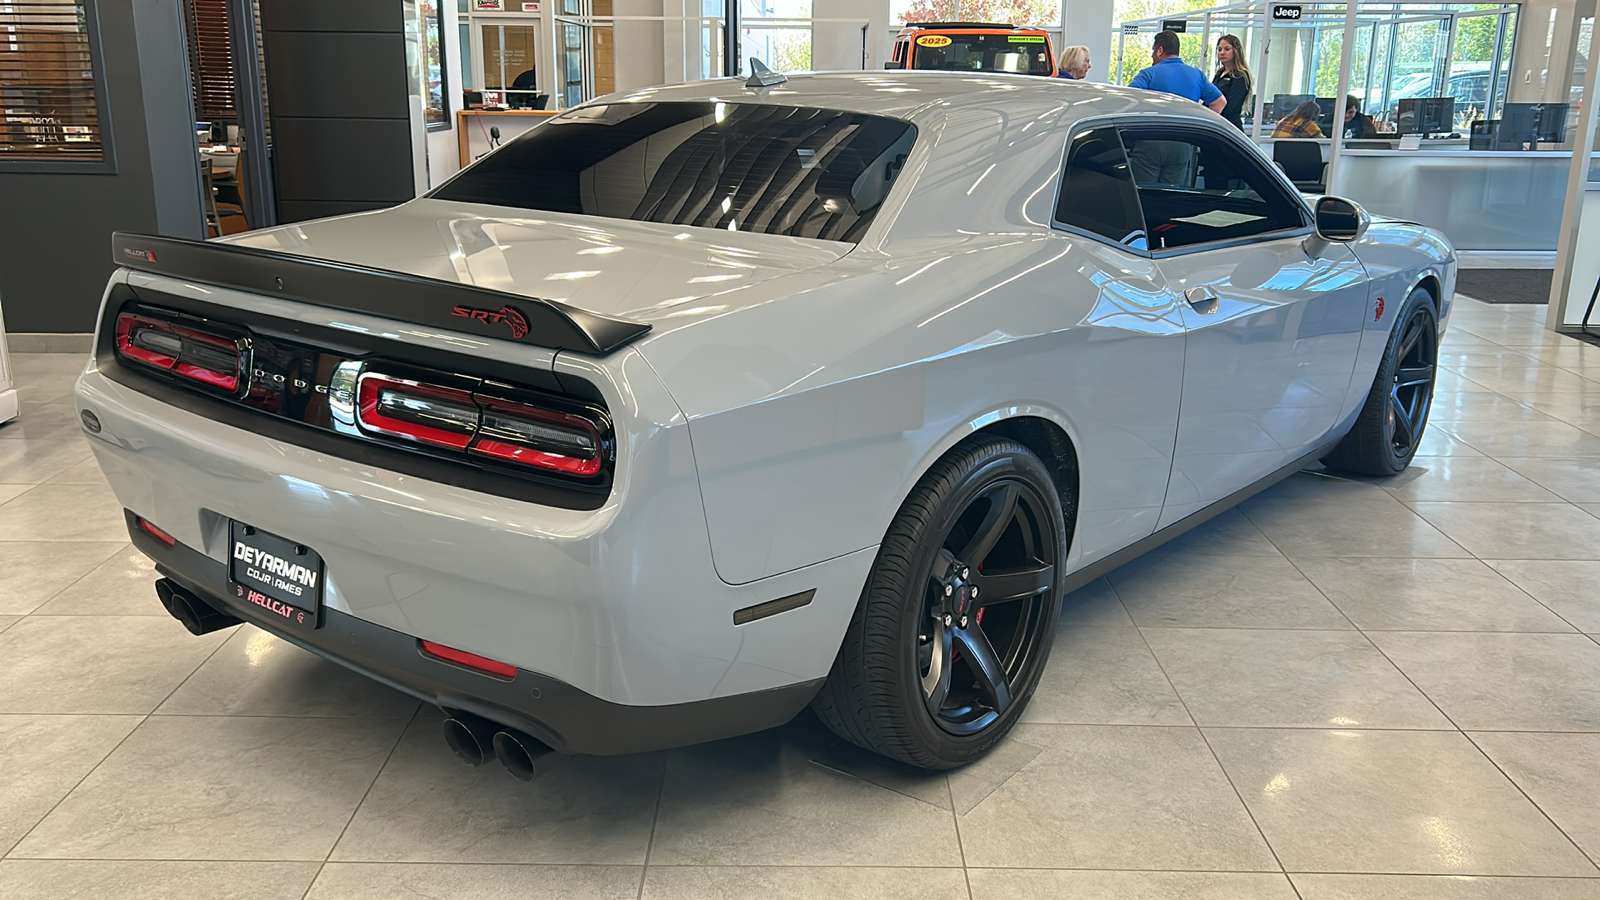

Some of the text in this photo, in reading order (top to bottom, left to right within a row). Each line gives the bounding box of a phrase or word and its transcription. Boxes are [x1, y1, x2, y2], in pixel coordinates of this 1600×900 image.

[1275, 7, 1299, 18] Jeep
[921, 37, 947, 45] 2025
[451, 306, 508, 325] SRT
[234, 541, 317, 588] DEYARMAN
[274, 578, 303, 596] AMES
[247, 590, 293, 618] HELLCAT
